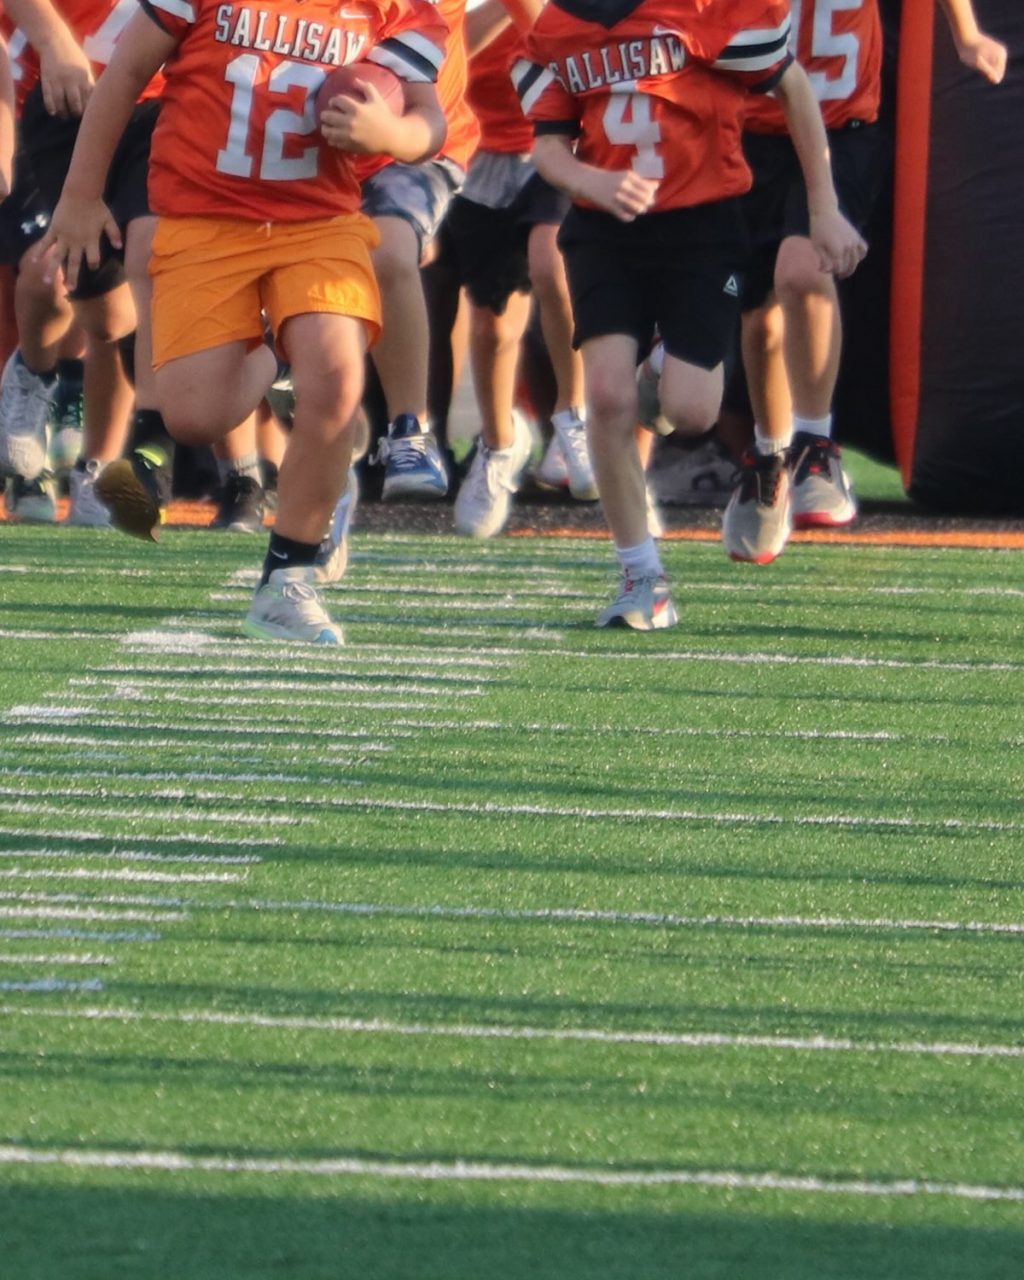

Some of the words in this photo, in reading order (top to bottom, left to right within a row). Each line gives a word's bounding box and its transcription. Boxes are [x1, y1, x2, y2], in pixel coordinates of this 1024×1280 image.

[214, 3, 367, 67] SALLISAW
[215, 53, 326, 181] 12
[602, 80, 666, 180] 4
